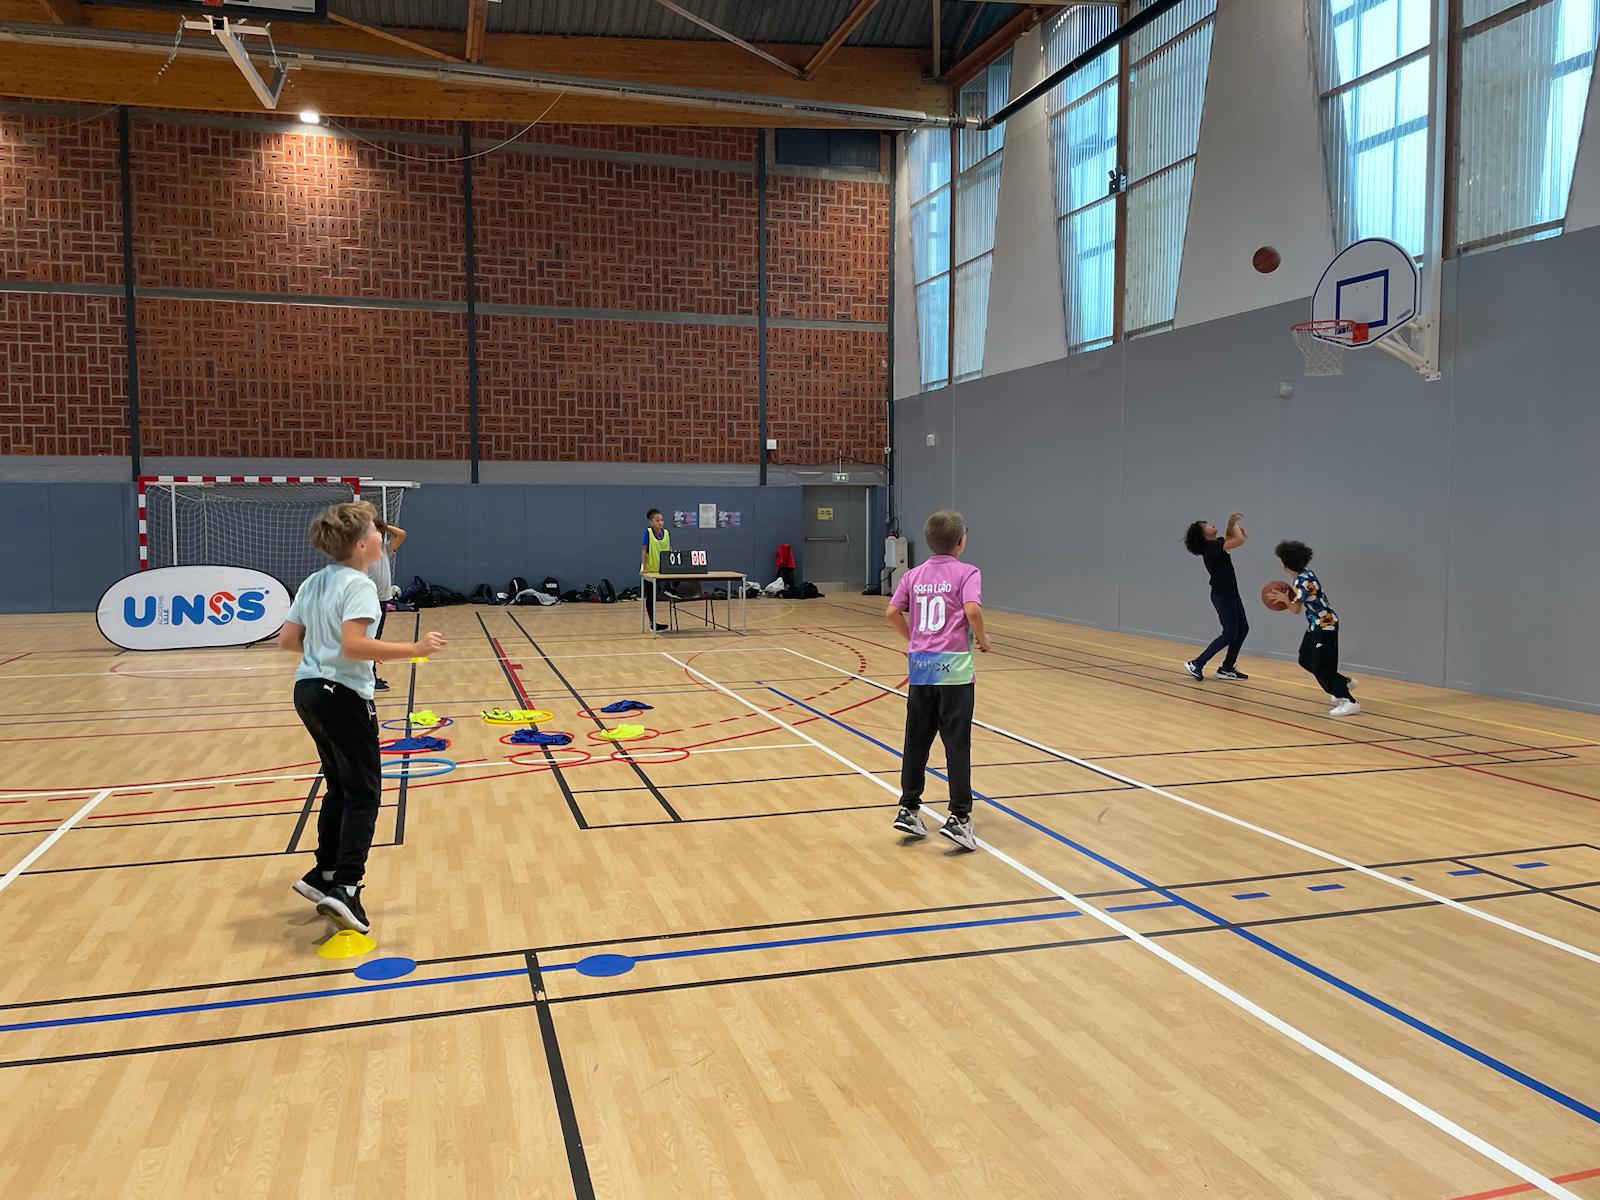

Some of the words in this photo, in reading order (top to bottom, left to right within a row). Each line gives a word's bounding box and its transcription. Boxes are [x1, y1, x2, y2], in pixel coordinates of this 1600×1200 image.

[670, 553, 681, 565] 01
[692, 552, 706, 564] 00
[124, 591, 265, 628] UNSS
[916, 596, 945, 632] 10
